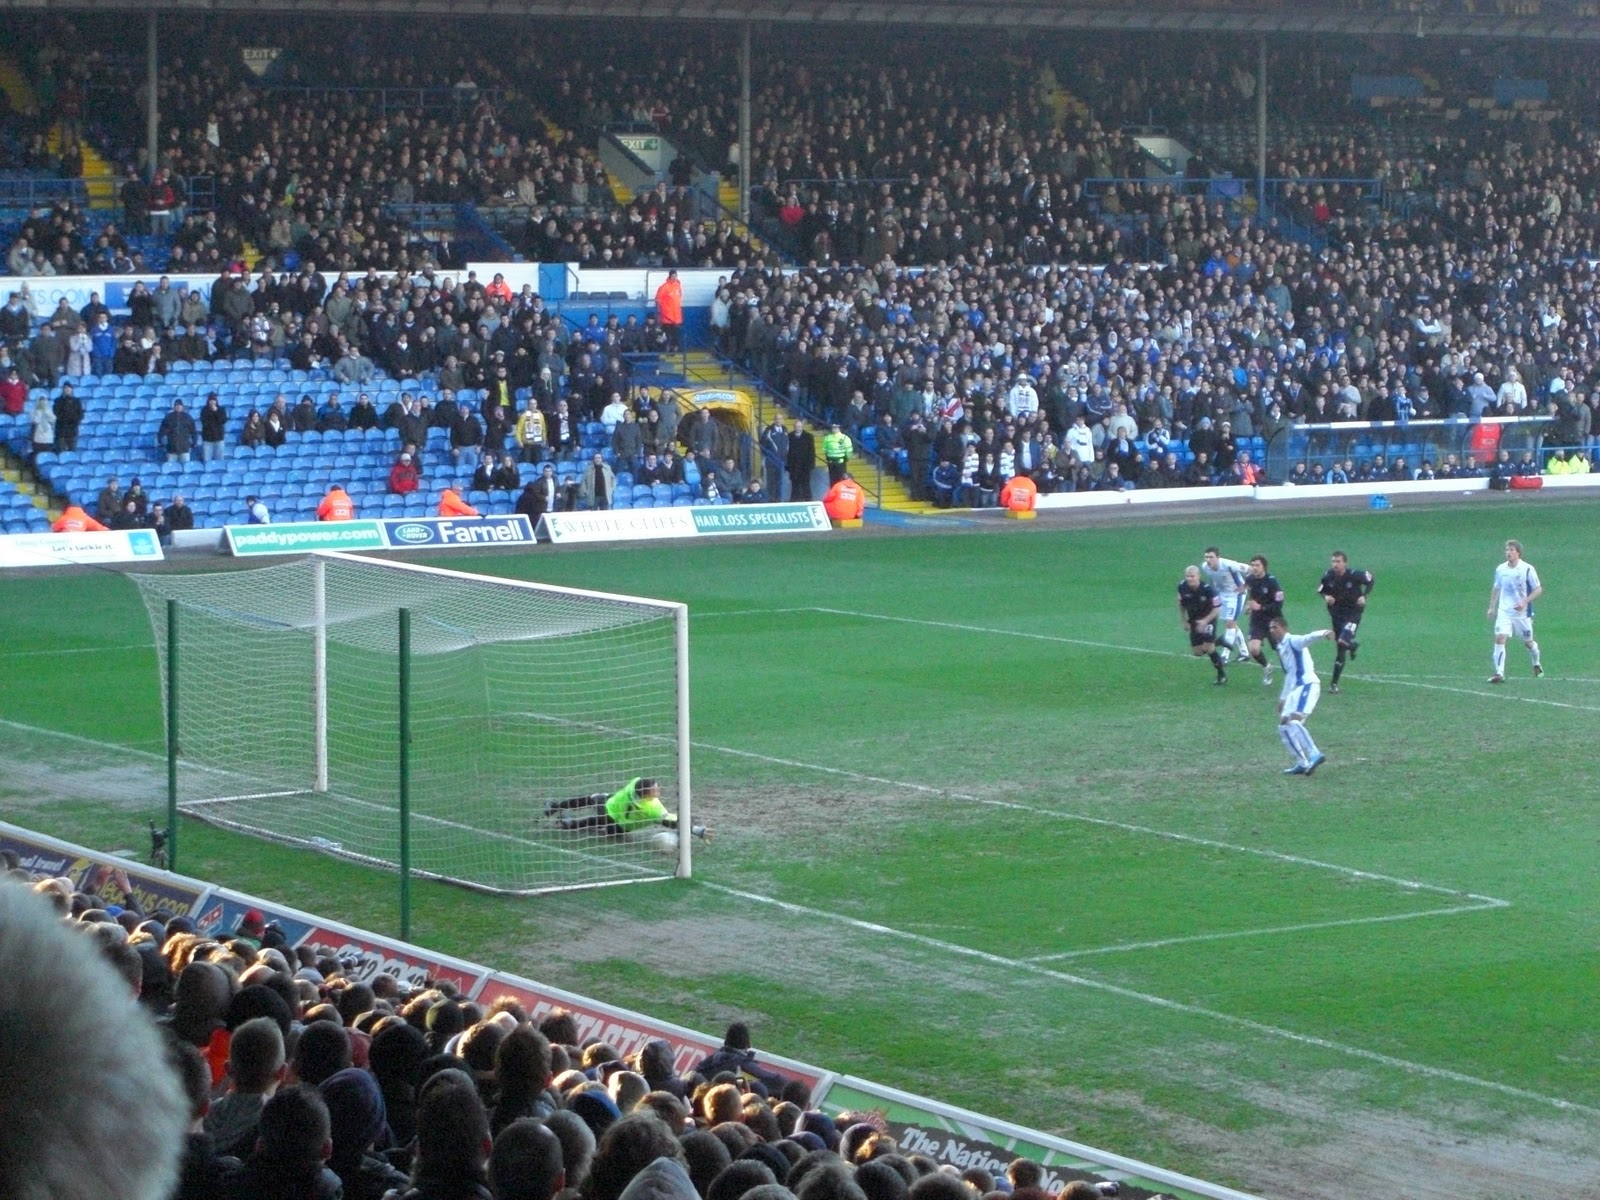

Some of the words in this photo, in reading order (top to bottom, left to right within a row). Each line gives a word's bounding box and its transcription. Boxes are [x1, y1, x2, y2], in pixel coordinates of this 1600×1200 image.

[243, 49, 270, 59] EXIT
[695, 514, 721, 527] HAIR
[722, 513, 748, 526] LOSS
[750, 511, 811, 525] SPECIALISTS
[234, 528, 379, 548] paddypower.com
[437, 519, 524, 543] Farnell
[900, 1127, 940, 1156] The
